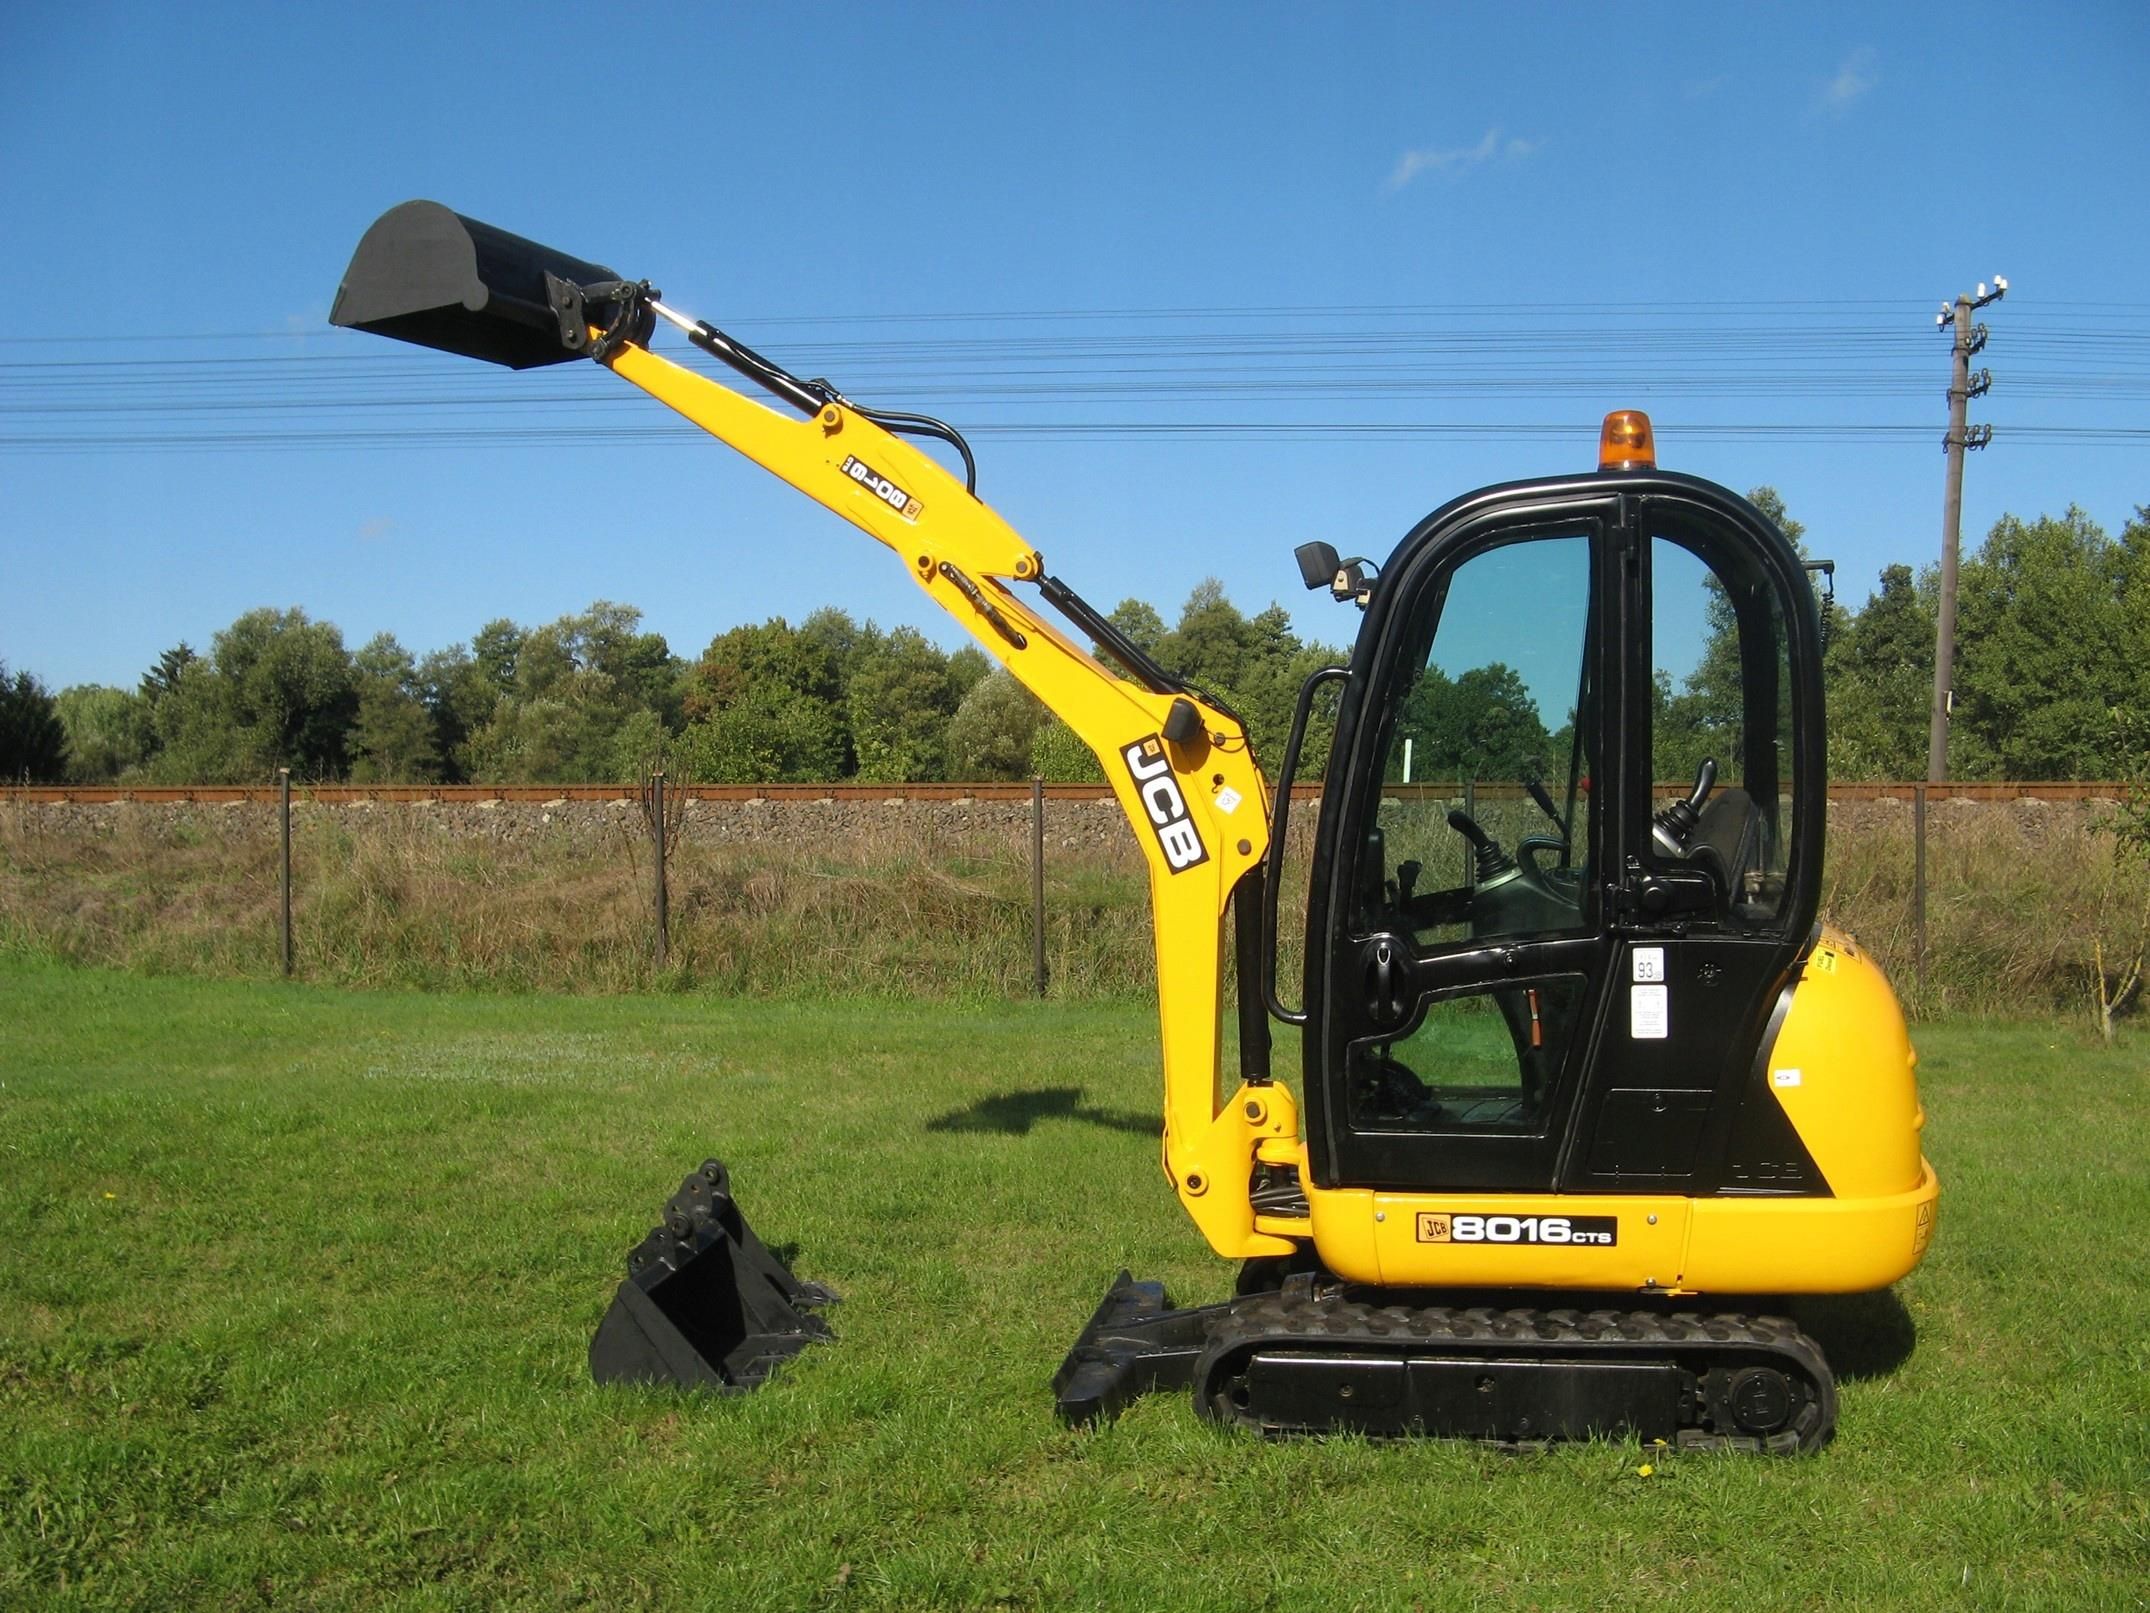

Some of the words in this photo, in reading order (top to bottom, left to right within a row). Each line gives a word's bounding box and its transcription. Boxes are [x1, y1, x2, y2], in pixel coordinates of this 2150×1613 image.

[849, 462, 908, 509] 8016
[1126, 745, 1202, 868] JCB
[1638, 961, 1654, 979] 93
[1426, 1219, 1448, 1237] JCB
